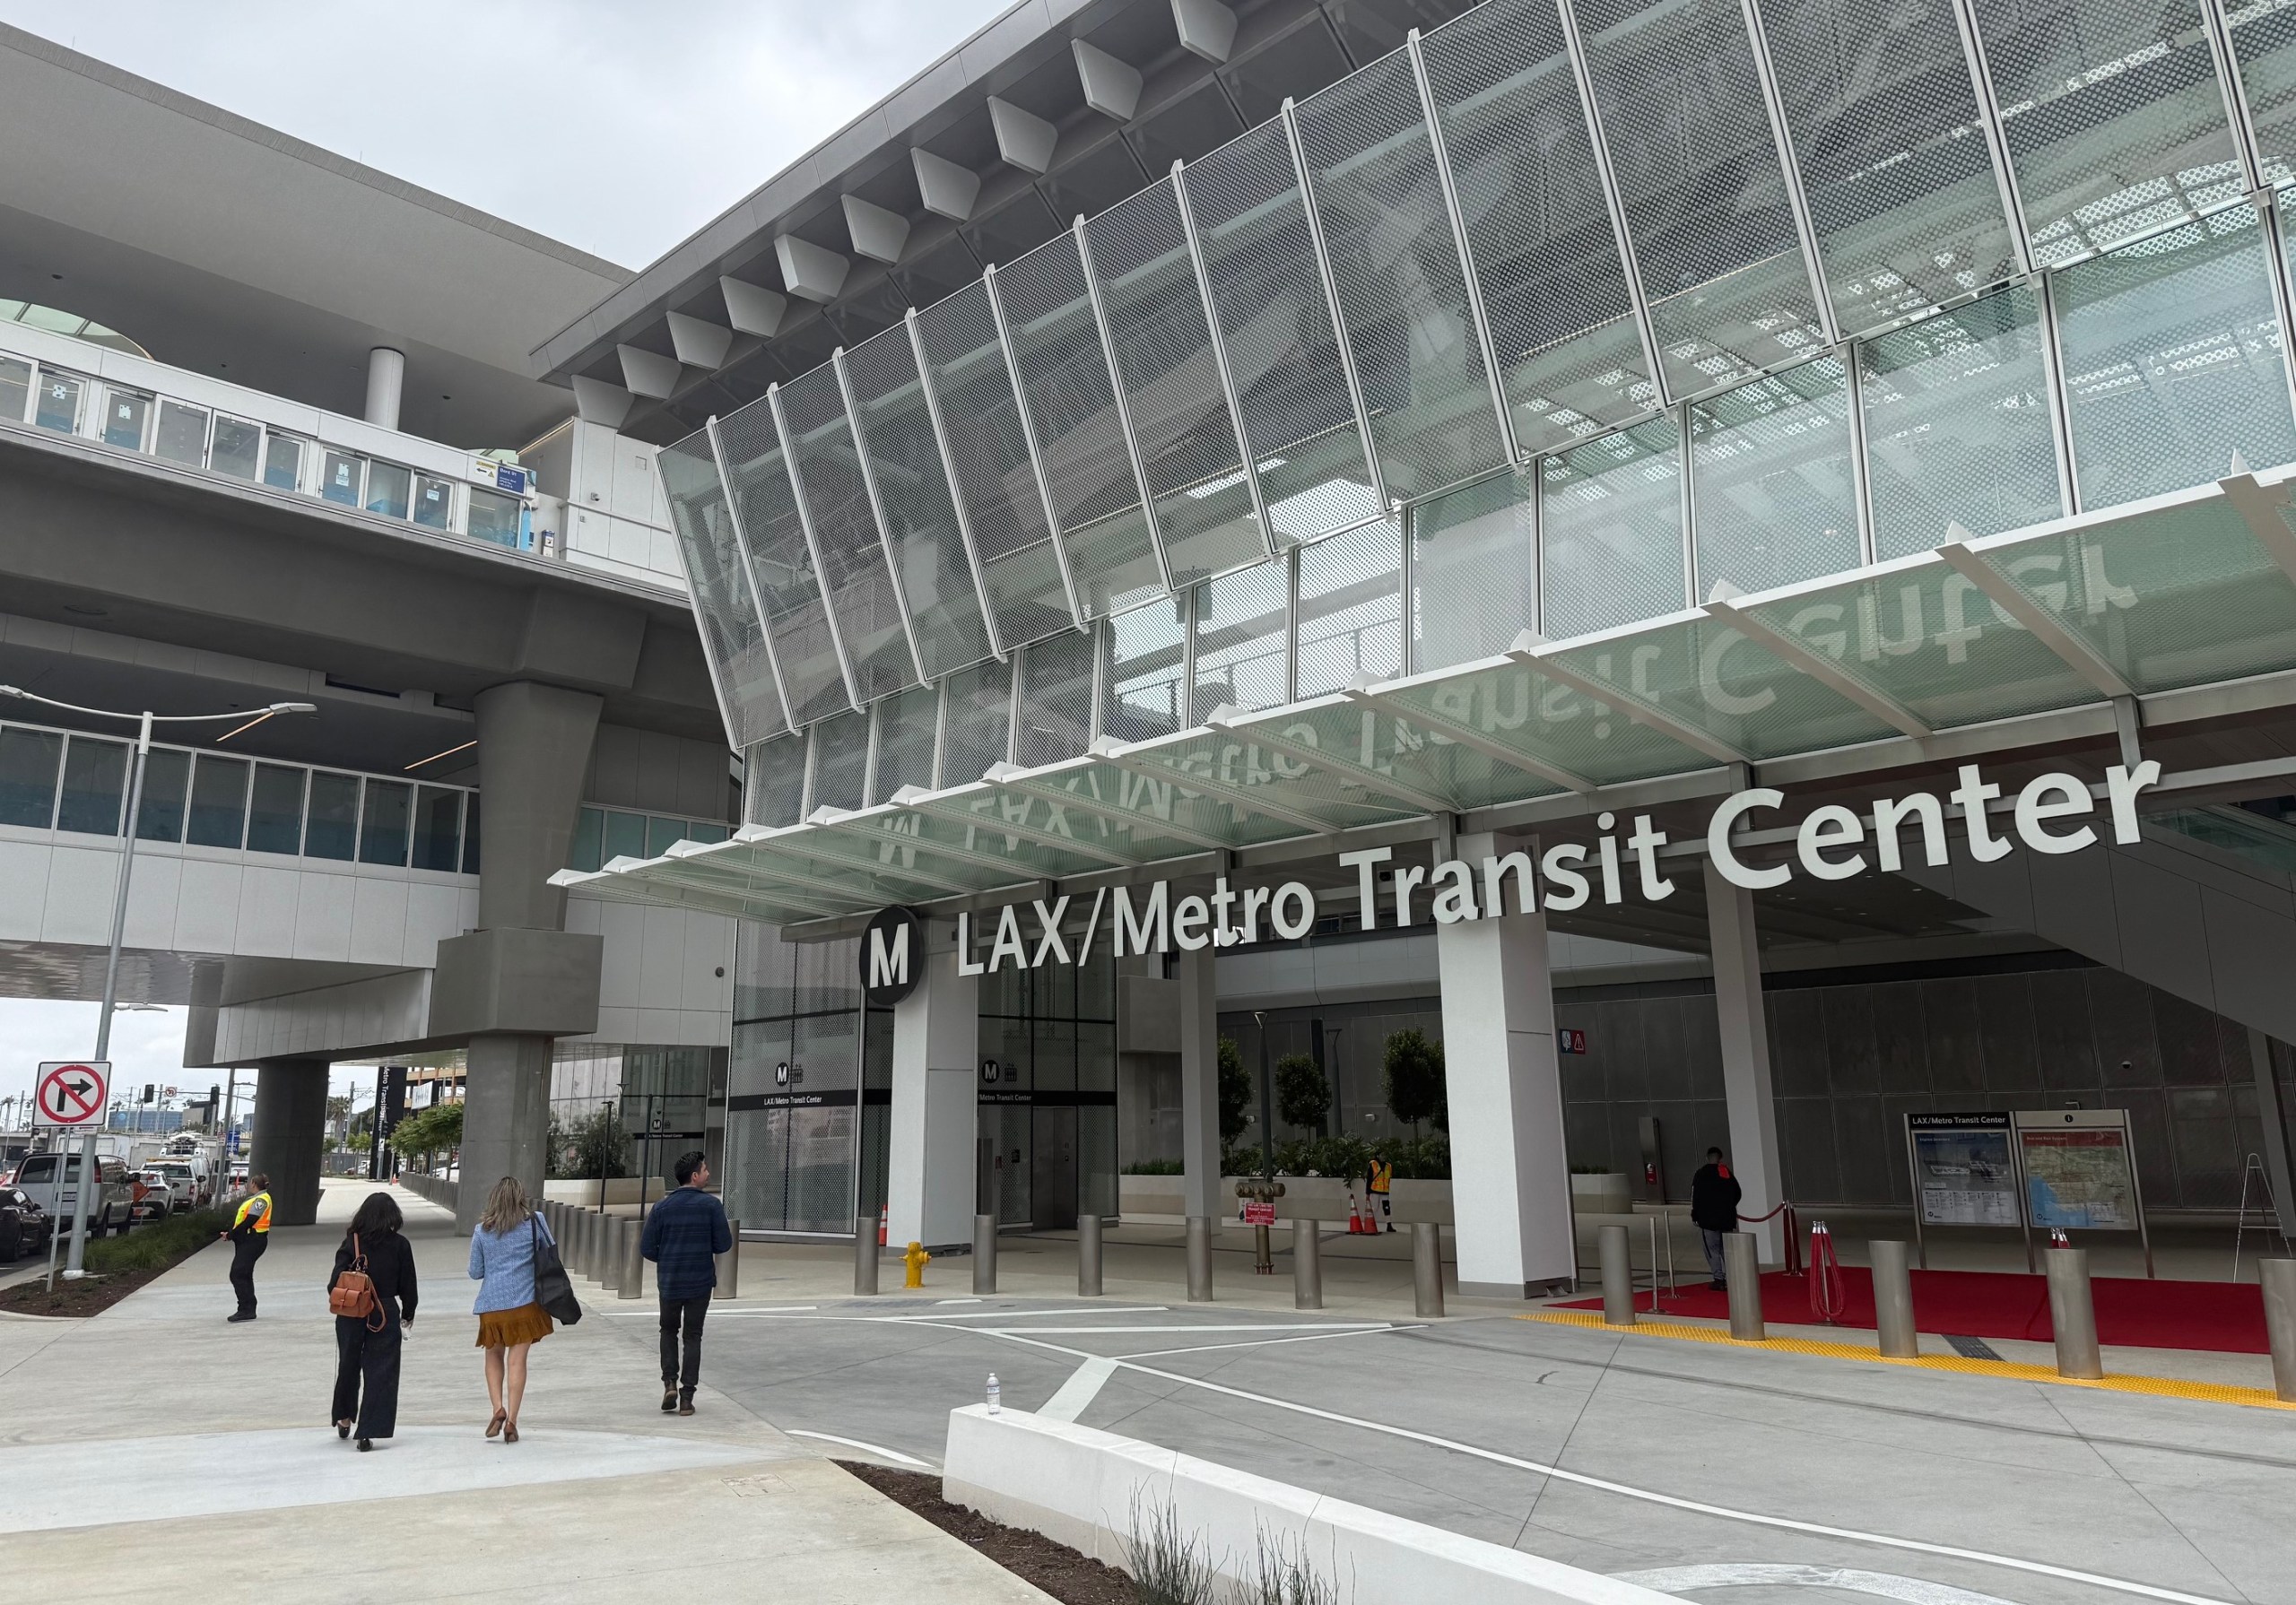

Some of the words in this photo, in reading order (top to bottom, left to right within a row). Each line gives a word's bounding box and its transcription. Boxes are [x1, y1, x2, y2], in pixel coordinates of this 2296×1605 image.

[957, 877, 1319, 977] LAX/Metro
[1339, 811, 1676, 932] Transit
[1707, 759, 2162, 890] Center
[868, 922, 910, 989] M
[985, 1063, 997, 1080] M
[790, 1096, 805, 1104] Transit
[806, 1096, 822, 1104] Center
[1912, 1116, 1952, 1124] LAX/Metro
